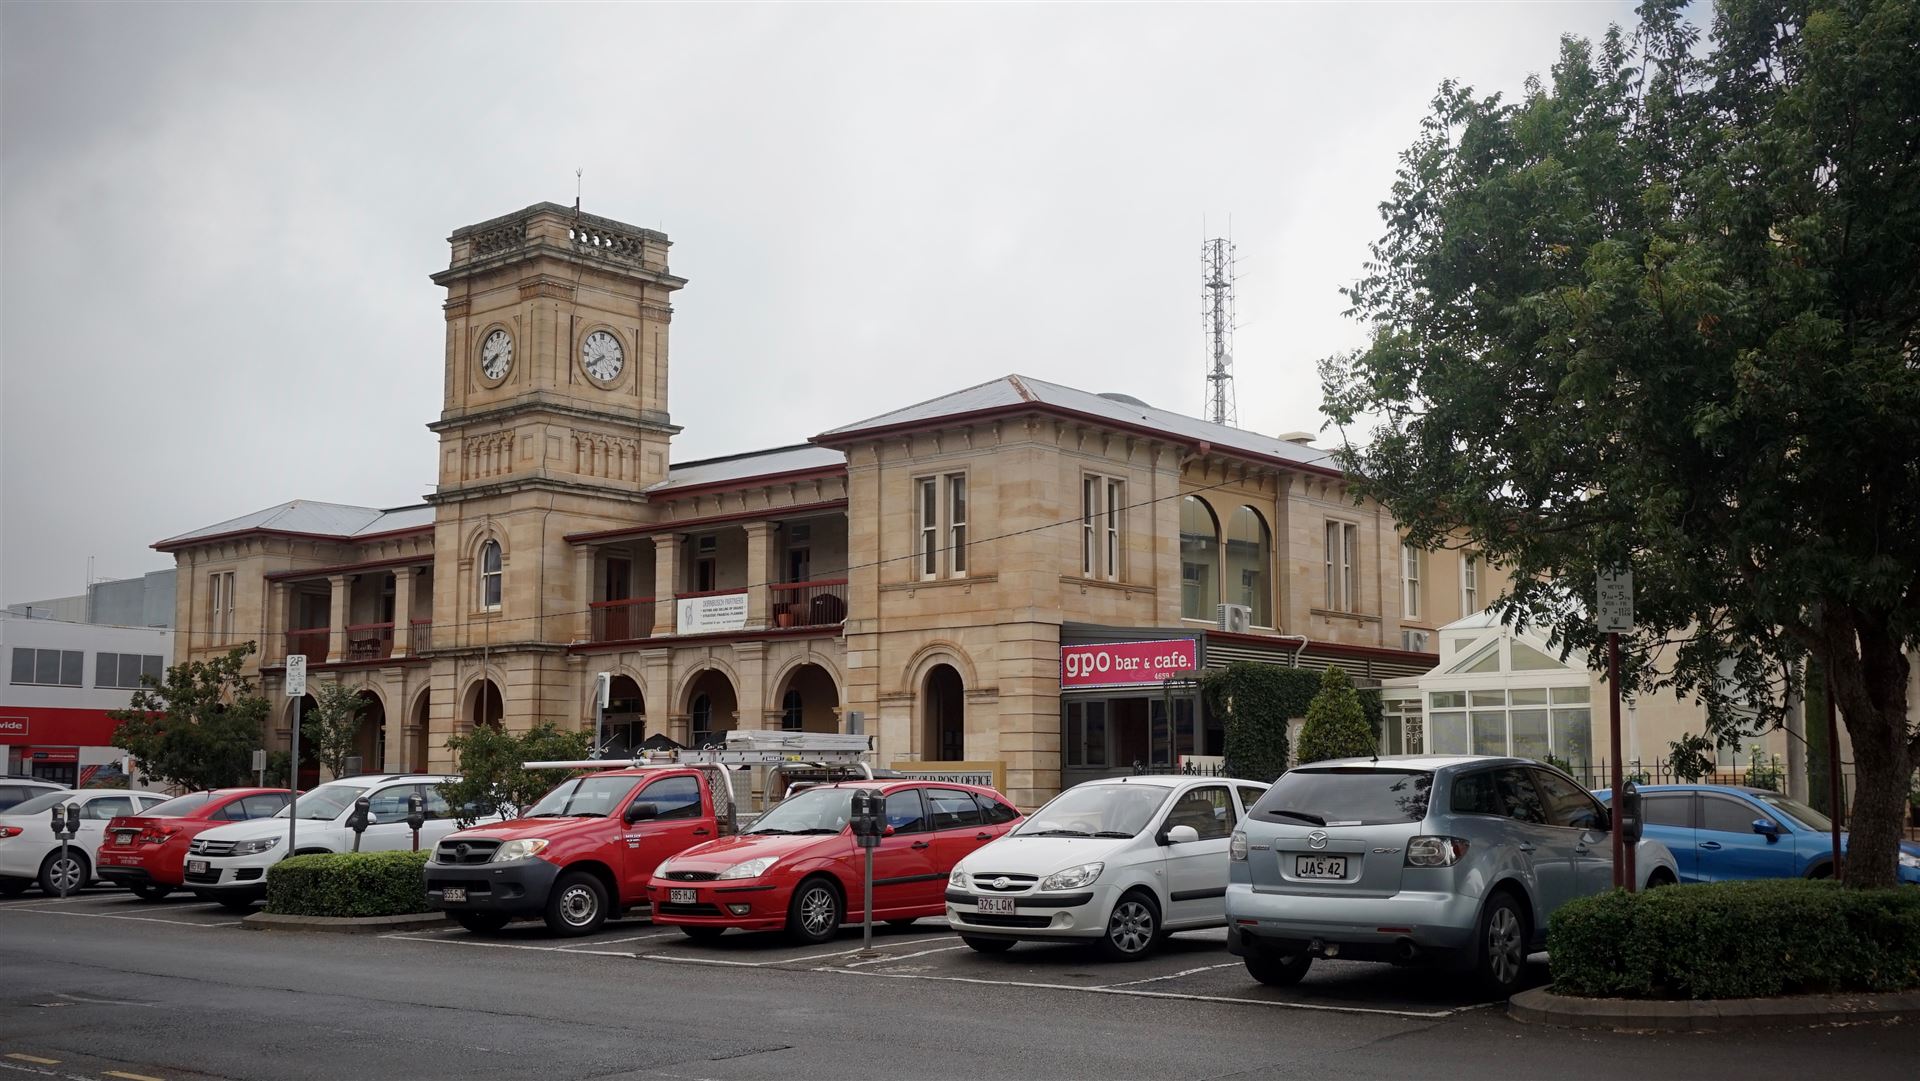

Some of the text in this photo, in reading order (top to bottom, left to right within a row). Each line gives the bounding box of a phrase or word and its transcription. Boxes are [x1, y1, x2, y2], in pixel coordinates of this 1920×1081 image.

[1066, 651, 1191, 677] gpo bar & cafe.
[961, 776, 992, 786] OFFICE
[1301, 861, 1341, 875] JAS 42
[979, 899, 1013, 911] 326 LQK
